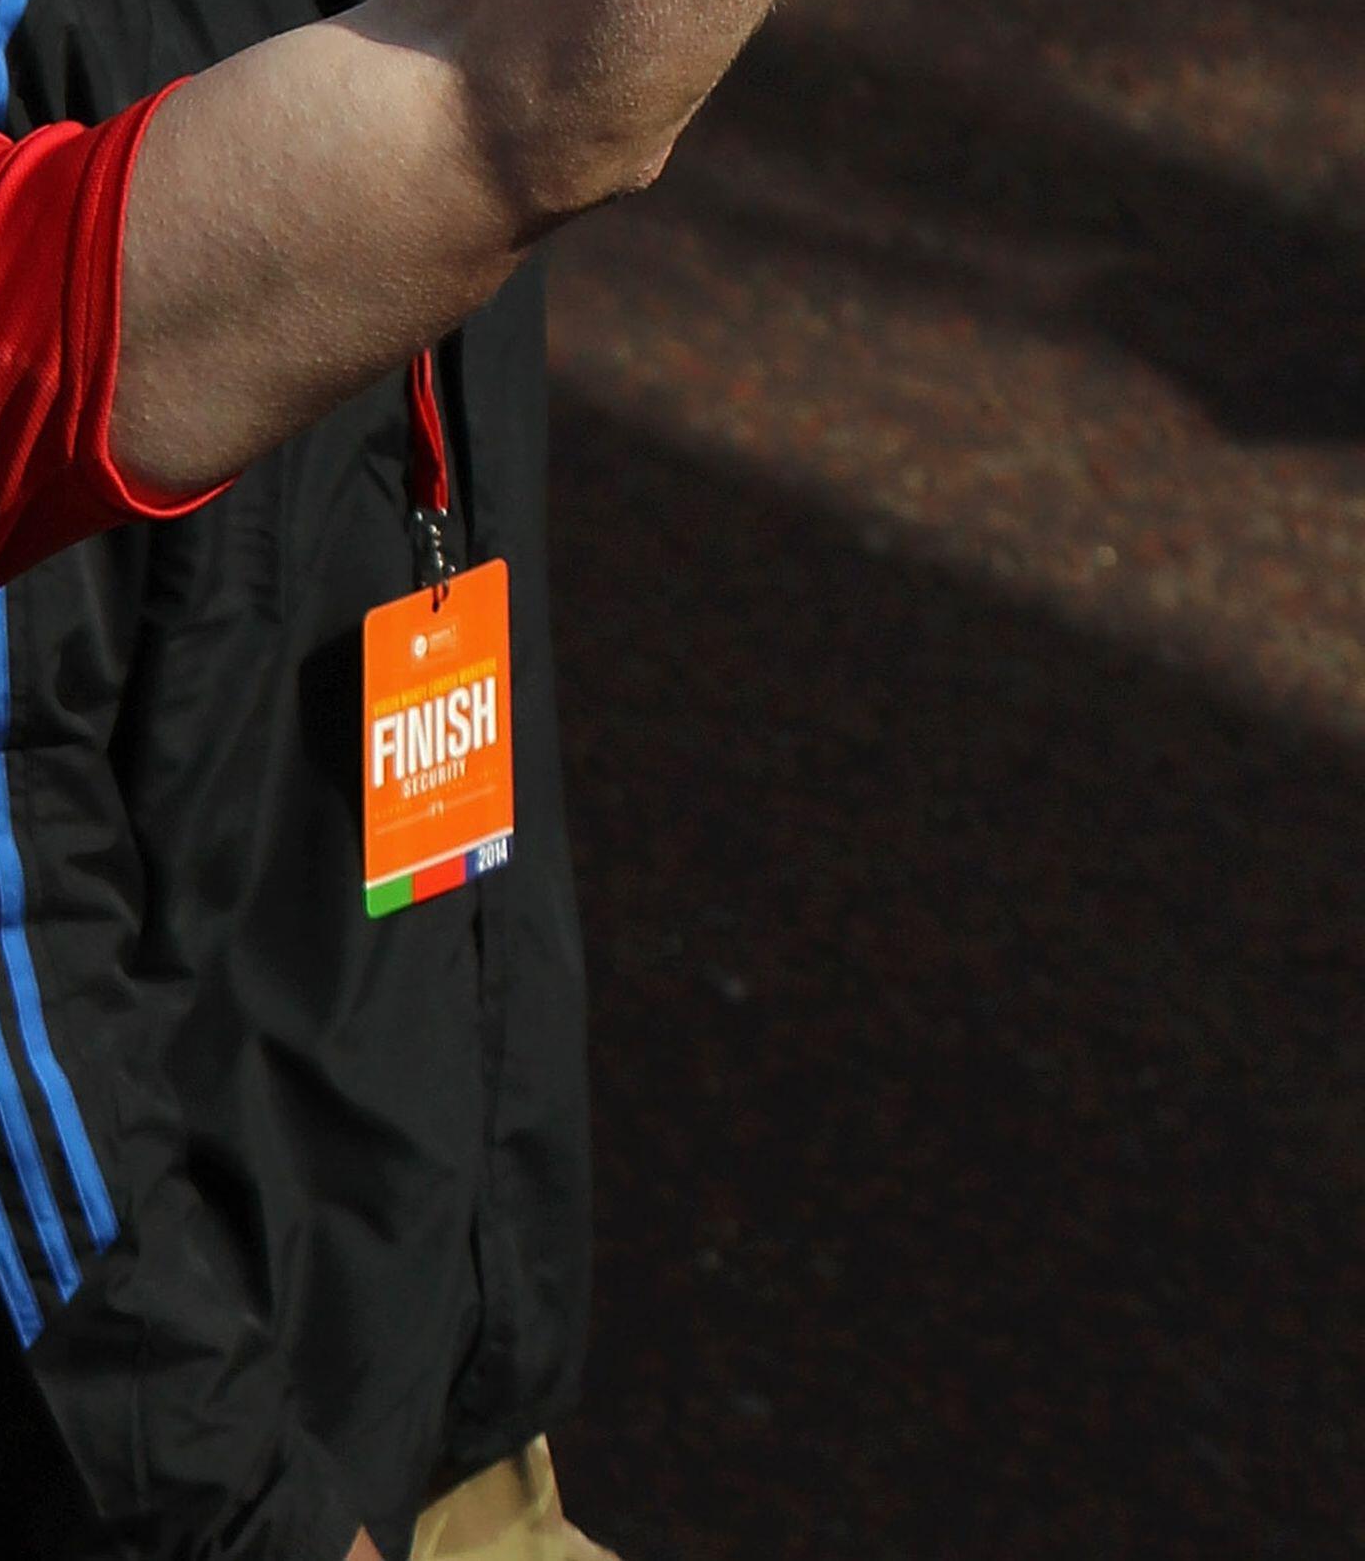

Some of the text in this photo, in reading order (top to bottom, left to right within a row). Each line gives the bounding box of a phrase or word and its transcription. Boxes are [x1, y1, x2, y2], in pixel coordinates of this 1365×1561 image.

[372, 675, 498, 789] FINISH
[400, 757, 467, 799] SECURITY
[475, 837, 508, 873] 2014
